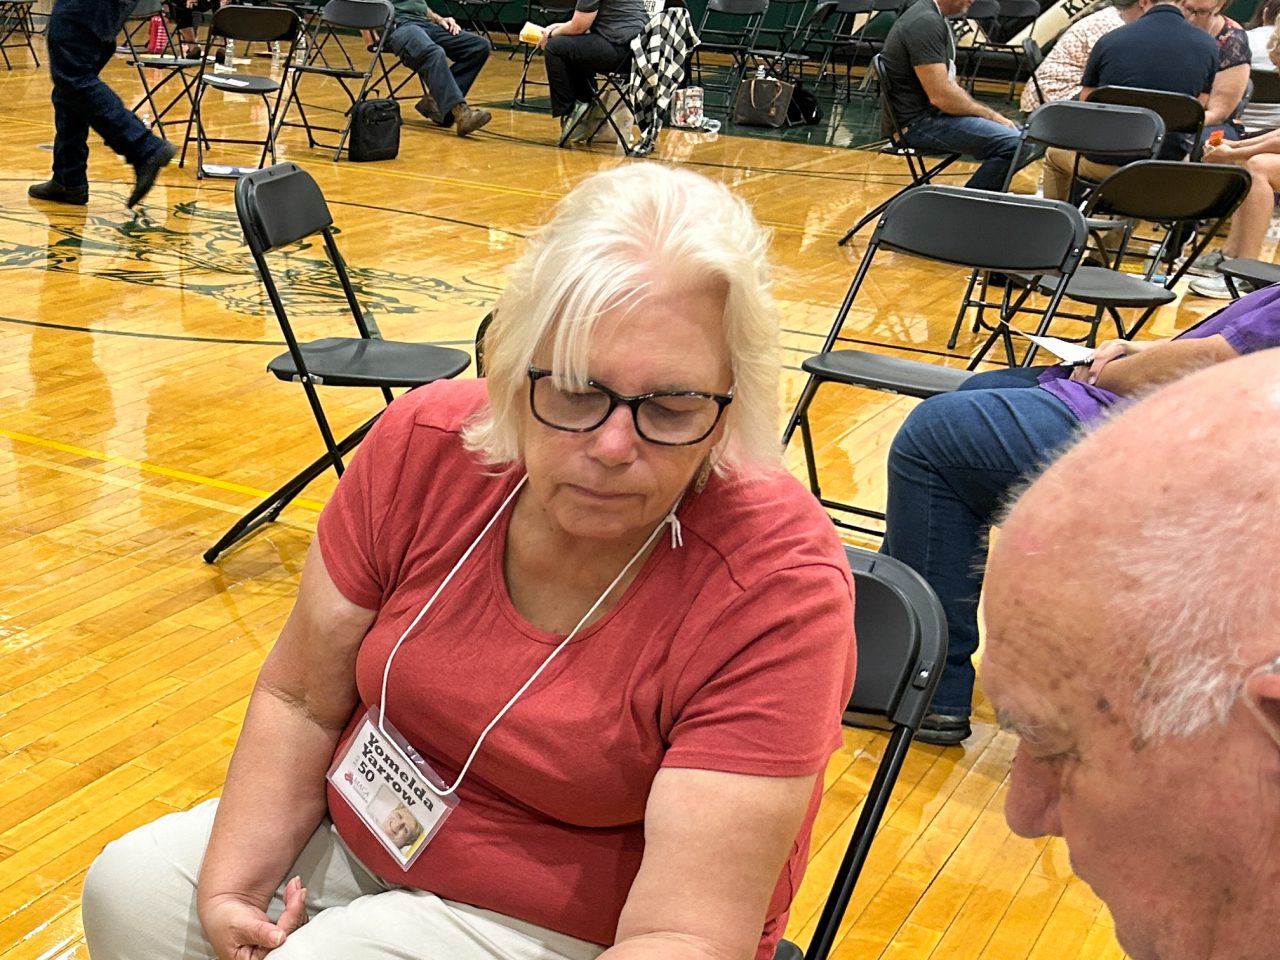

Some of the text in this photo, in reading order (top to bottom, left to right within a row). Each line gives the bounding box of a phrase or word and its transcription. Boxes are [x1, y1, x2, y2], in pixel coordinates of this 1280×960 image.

[357, 761, 375, 782] 50
[362, 743, 417, 807] Yarrow
[370, 731, 434, 812] Yomelda
